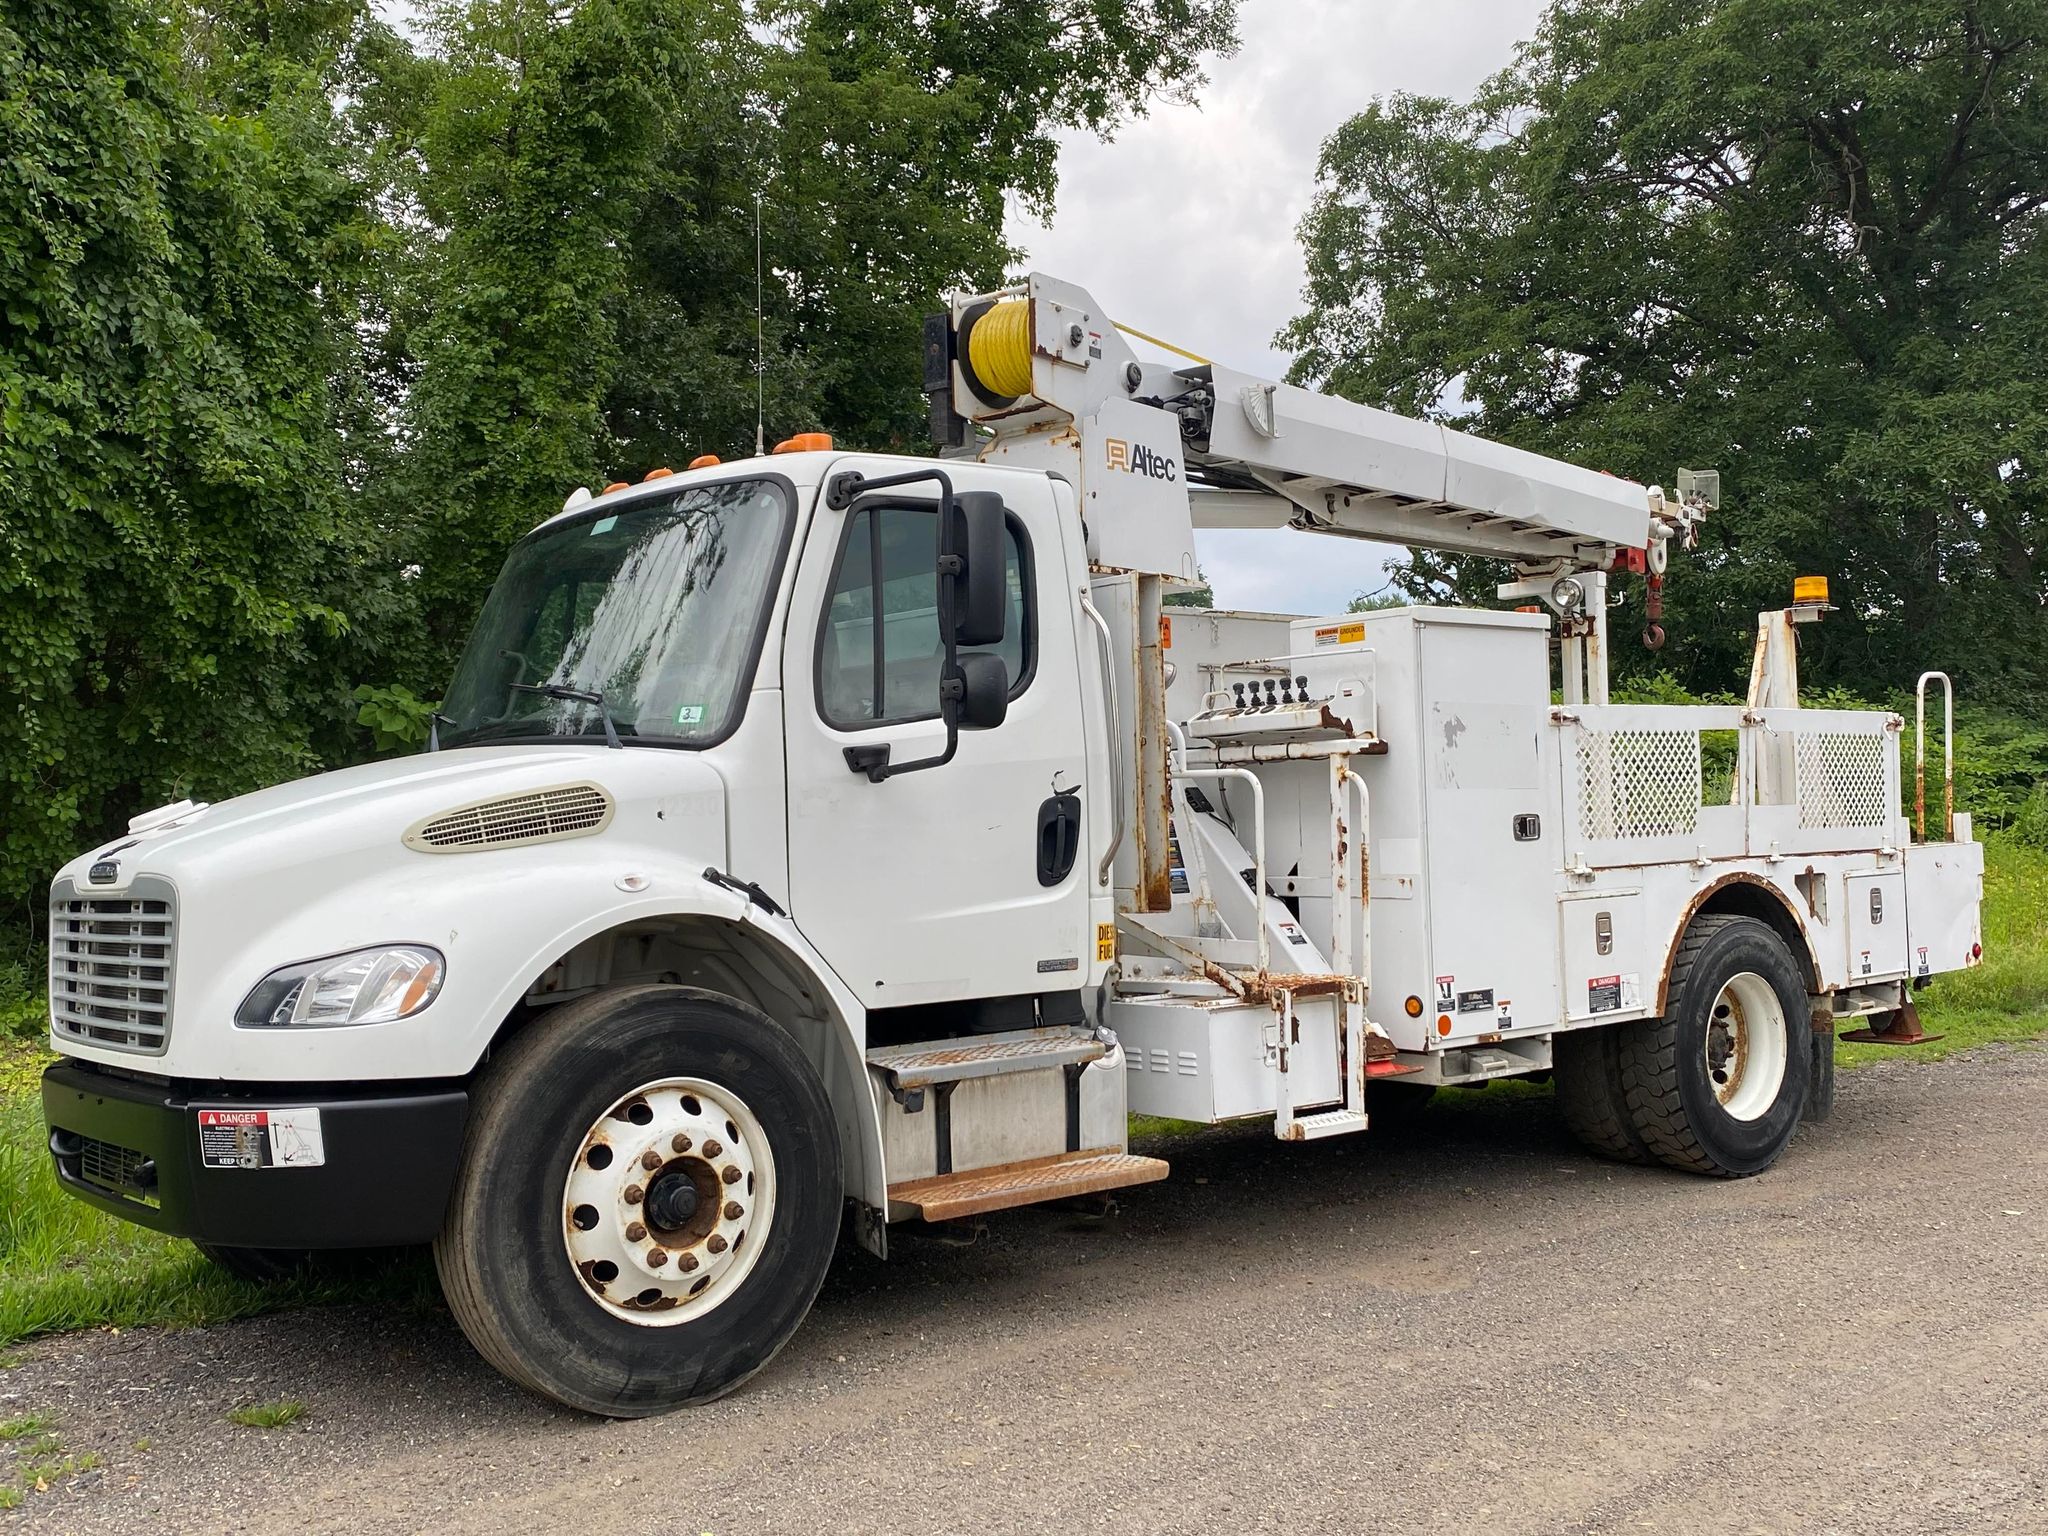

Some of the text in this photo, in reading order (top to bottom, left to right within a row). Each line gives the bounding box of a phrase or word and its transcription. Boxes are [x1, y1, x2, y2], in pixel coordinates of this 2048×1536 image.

[1130, 443, 1176, 482] Altec
[1340, 625, 1365, 635] GROUNDED
[1598, 976, 1617, 986] DANGER
[219, 1113, 258, 1124] DANGER
